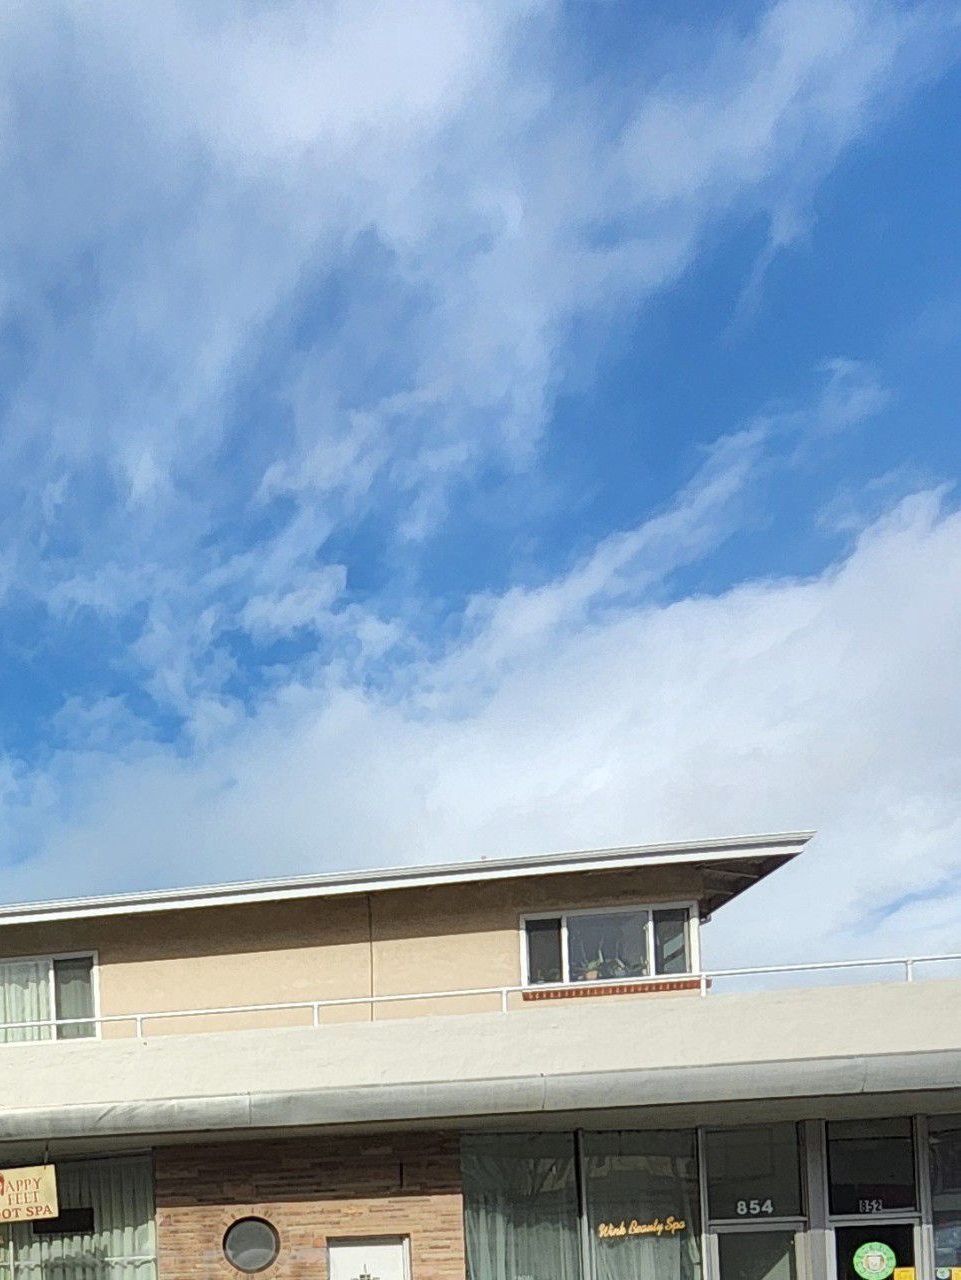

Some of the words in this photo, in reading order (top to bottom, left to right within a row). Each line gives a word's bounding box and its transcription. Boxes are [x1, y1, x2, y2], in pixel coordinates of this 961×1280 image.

[7, 1191, 39, 1206] FEET
[26, 1205, 53, 1217] SPA
[737, 1200, 774, 1215] 854
[664, 1216, 686, 1235] Spa
